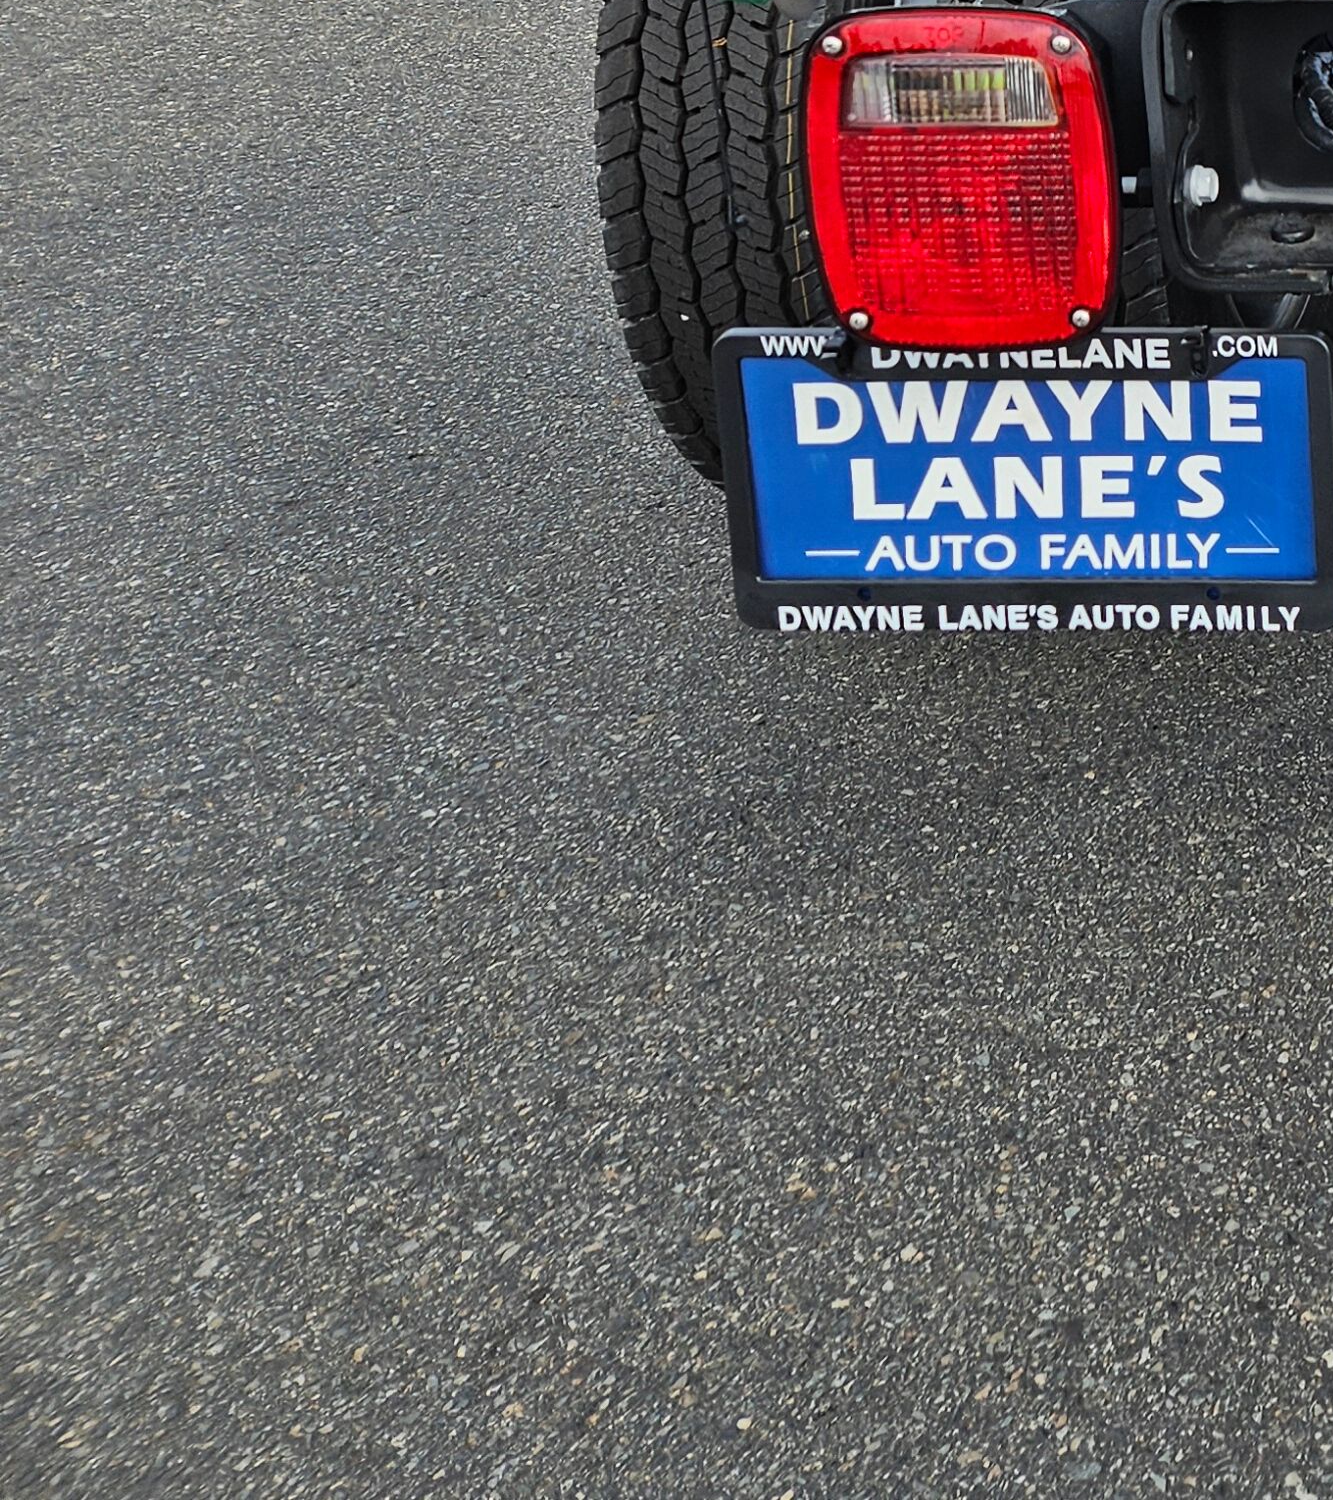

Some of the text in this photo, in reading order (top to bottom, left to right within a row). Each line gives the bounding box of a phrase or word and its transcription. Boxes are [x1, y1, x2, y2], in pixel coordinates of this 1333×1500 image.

[1211, 335, 1279, 358] .COM
[791, 379, 1263, 445] DWAYNE
[850, 454, 1225, 521] LANE'S
[865, 532, 1221, 571] AUTO FAMILY
[777, 603, 1301, 632] DWAYNE LANE'S AUTO FAMILY
